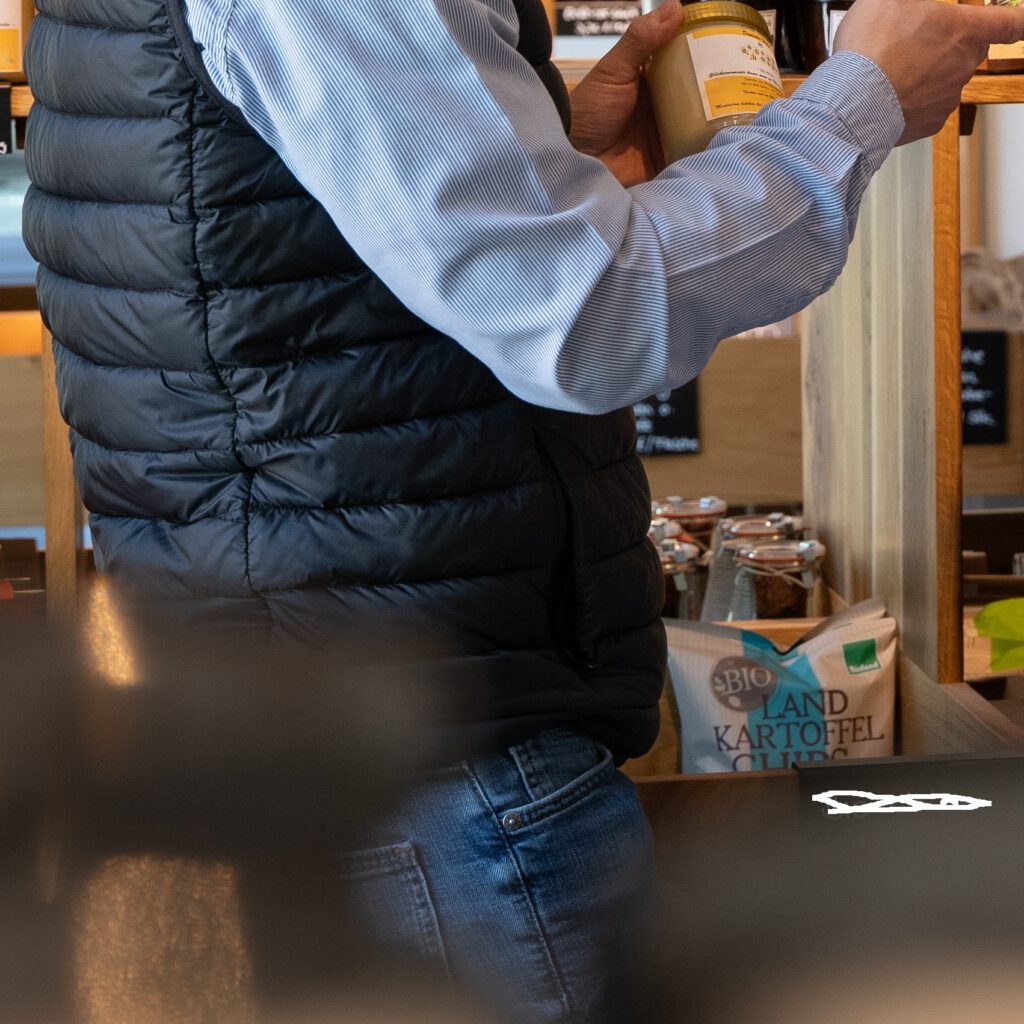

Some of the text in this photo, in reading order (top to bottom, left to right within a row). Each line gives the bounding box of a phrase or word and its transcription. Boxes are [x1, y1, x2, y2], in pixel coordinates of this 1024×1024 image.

[723, 666, 772, 694] BIO
[762, 689, 848, 720] LAND
[713, 716, 885, 752] KARTOFFEL
